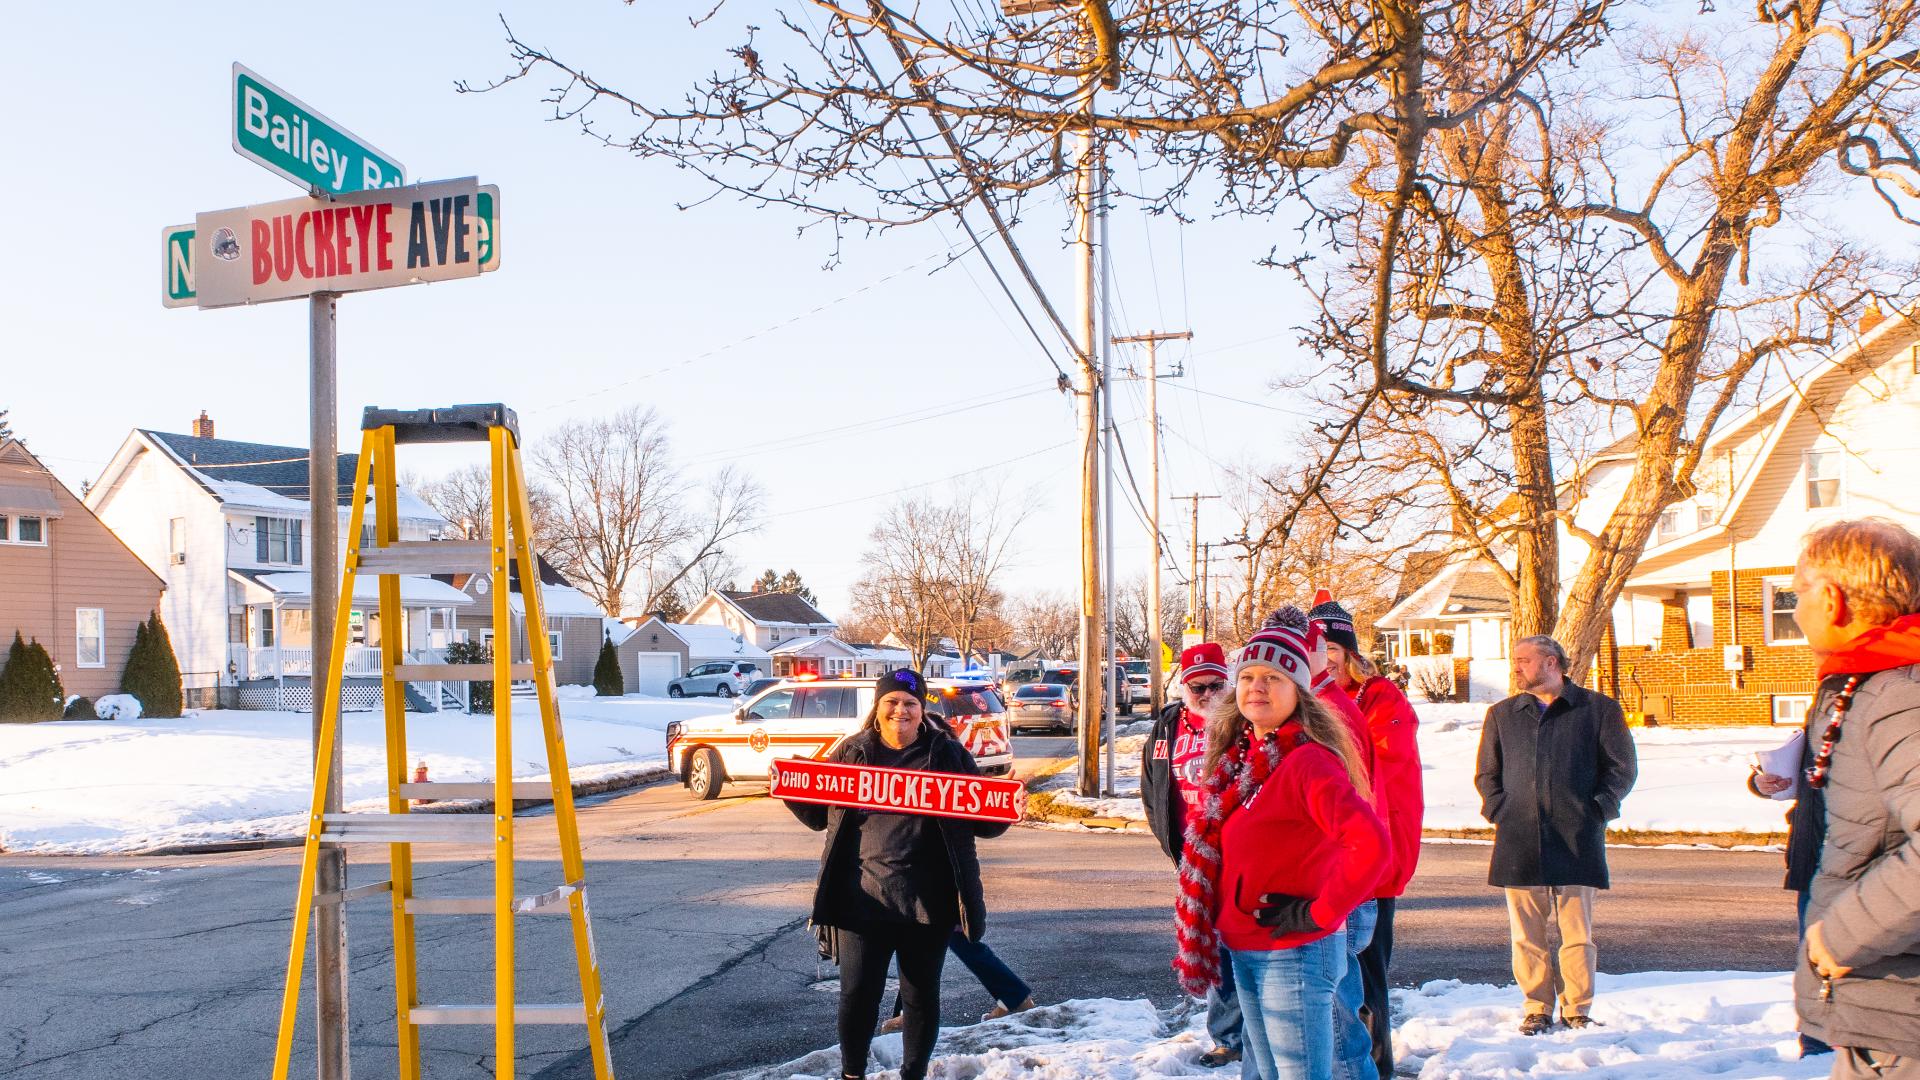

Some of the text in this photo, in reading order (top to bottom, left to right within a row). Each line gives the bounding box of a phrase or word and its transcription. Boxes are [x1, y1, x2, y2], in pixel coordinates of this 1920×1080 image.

[244, 84, 349, 190] Bailey
[251, 195, 470, 286] BUCKEYE AVE
[1236, 644, 1298, 673] HIO
[781, 770, 1010, 814] OHIO STATE BUCKEYES AVE
